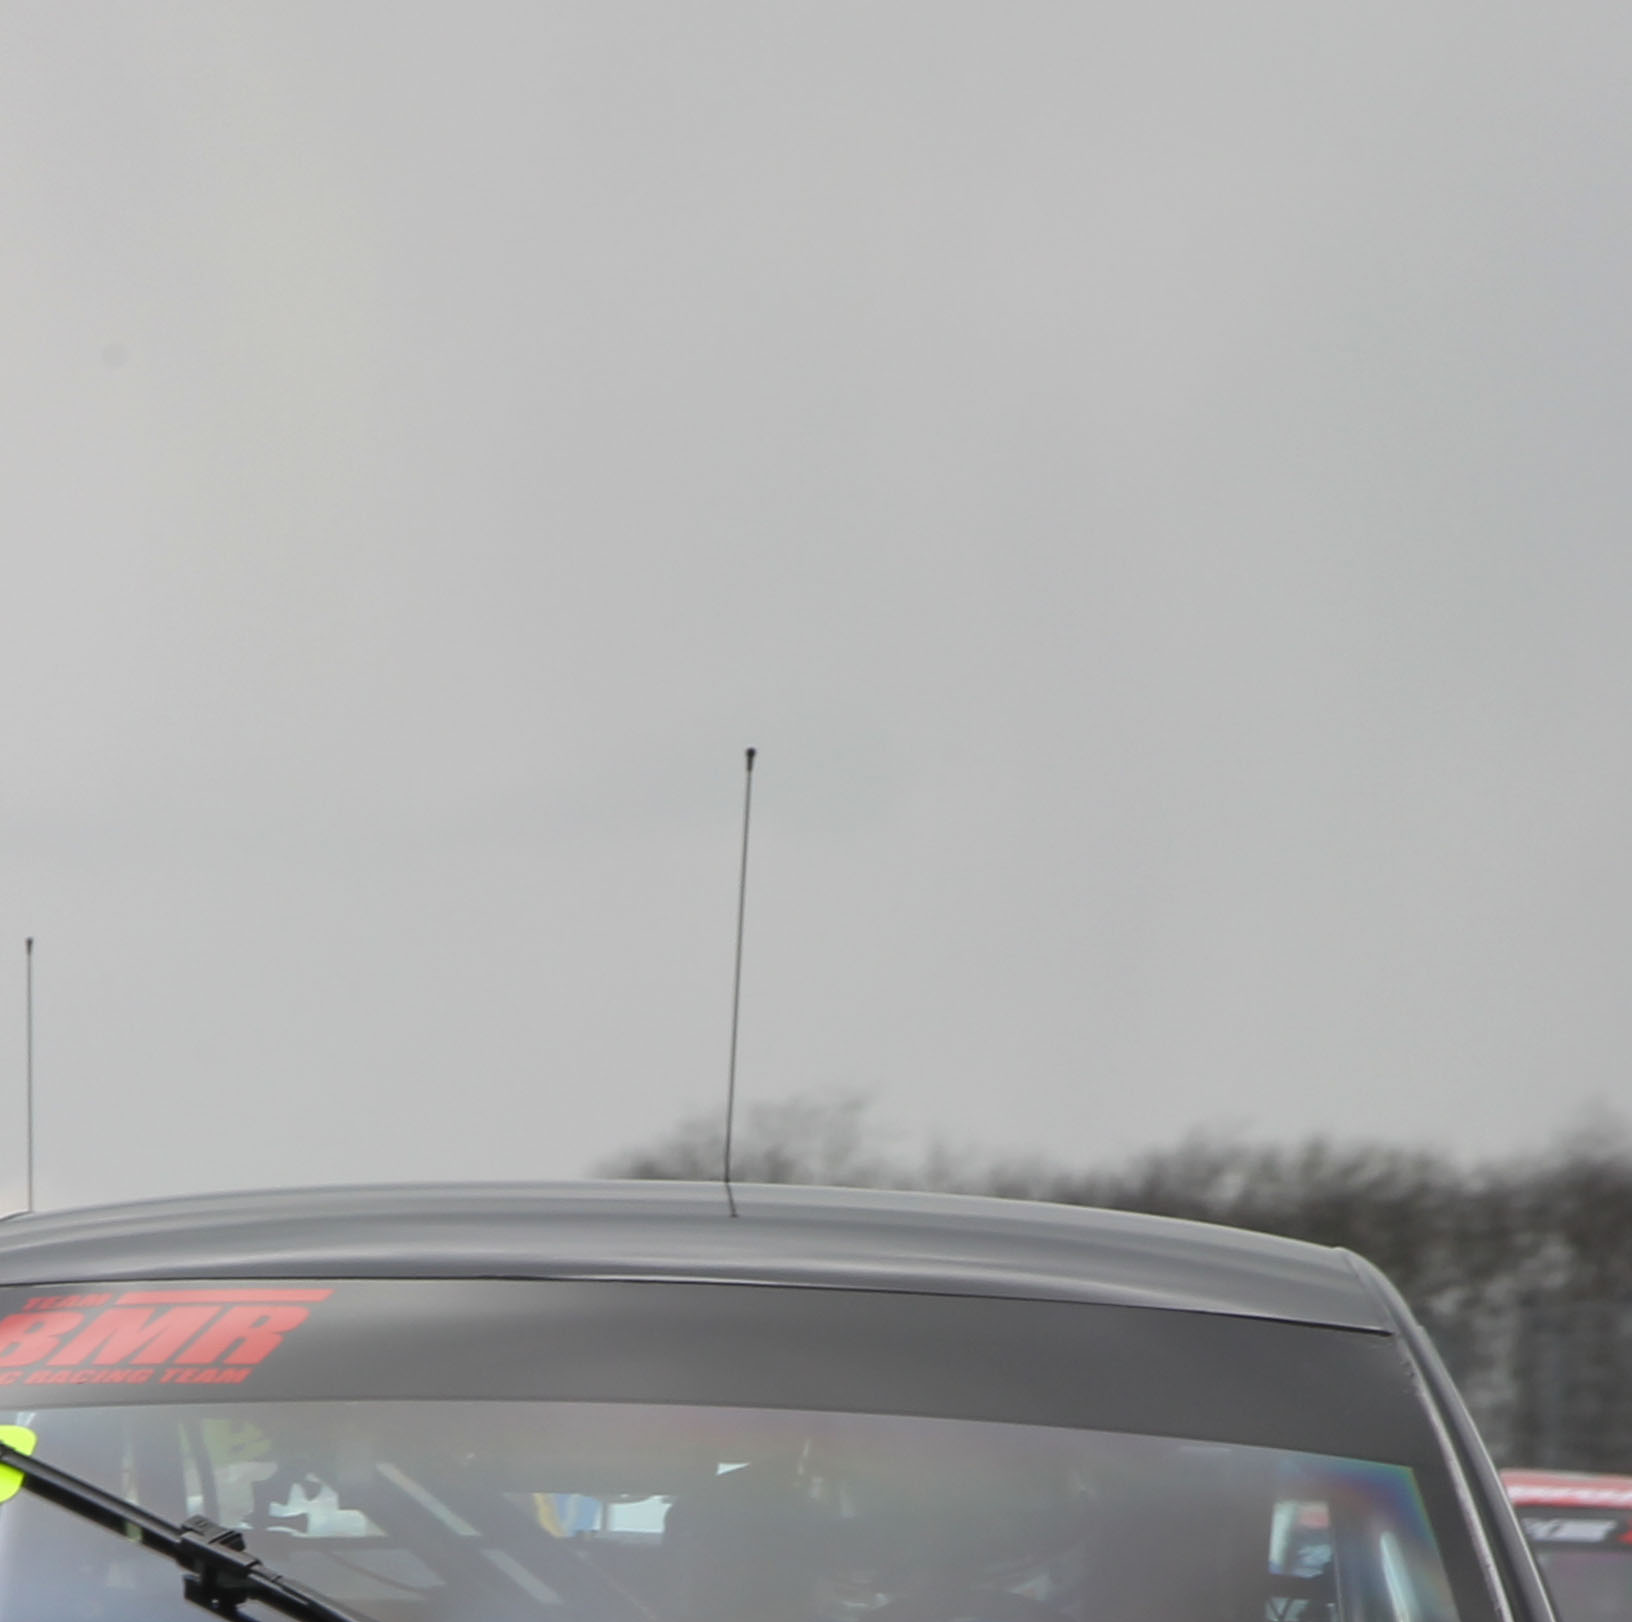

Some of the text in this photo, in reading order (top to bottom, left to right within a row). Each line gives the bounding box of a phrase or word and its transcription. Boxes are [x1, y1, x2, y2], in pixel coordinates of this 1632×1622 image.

[21, 1292, 112, 1311] TEAM
[23, 1369, 156, 1385] RACING
[158, 1368, 255, 1384] TEAM
